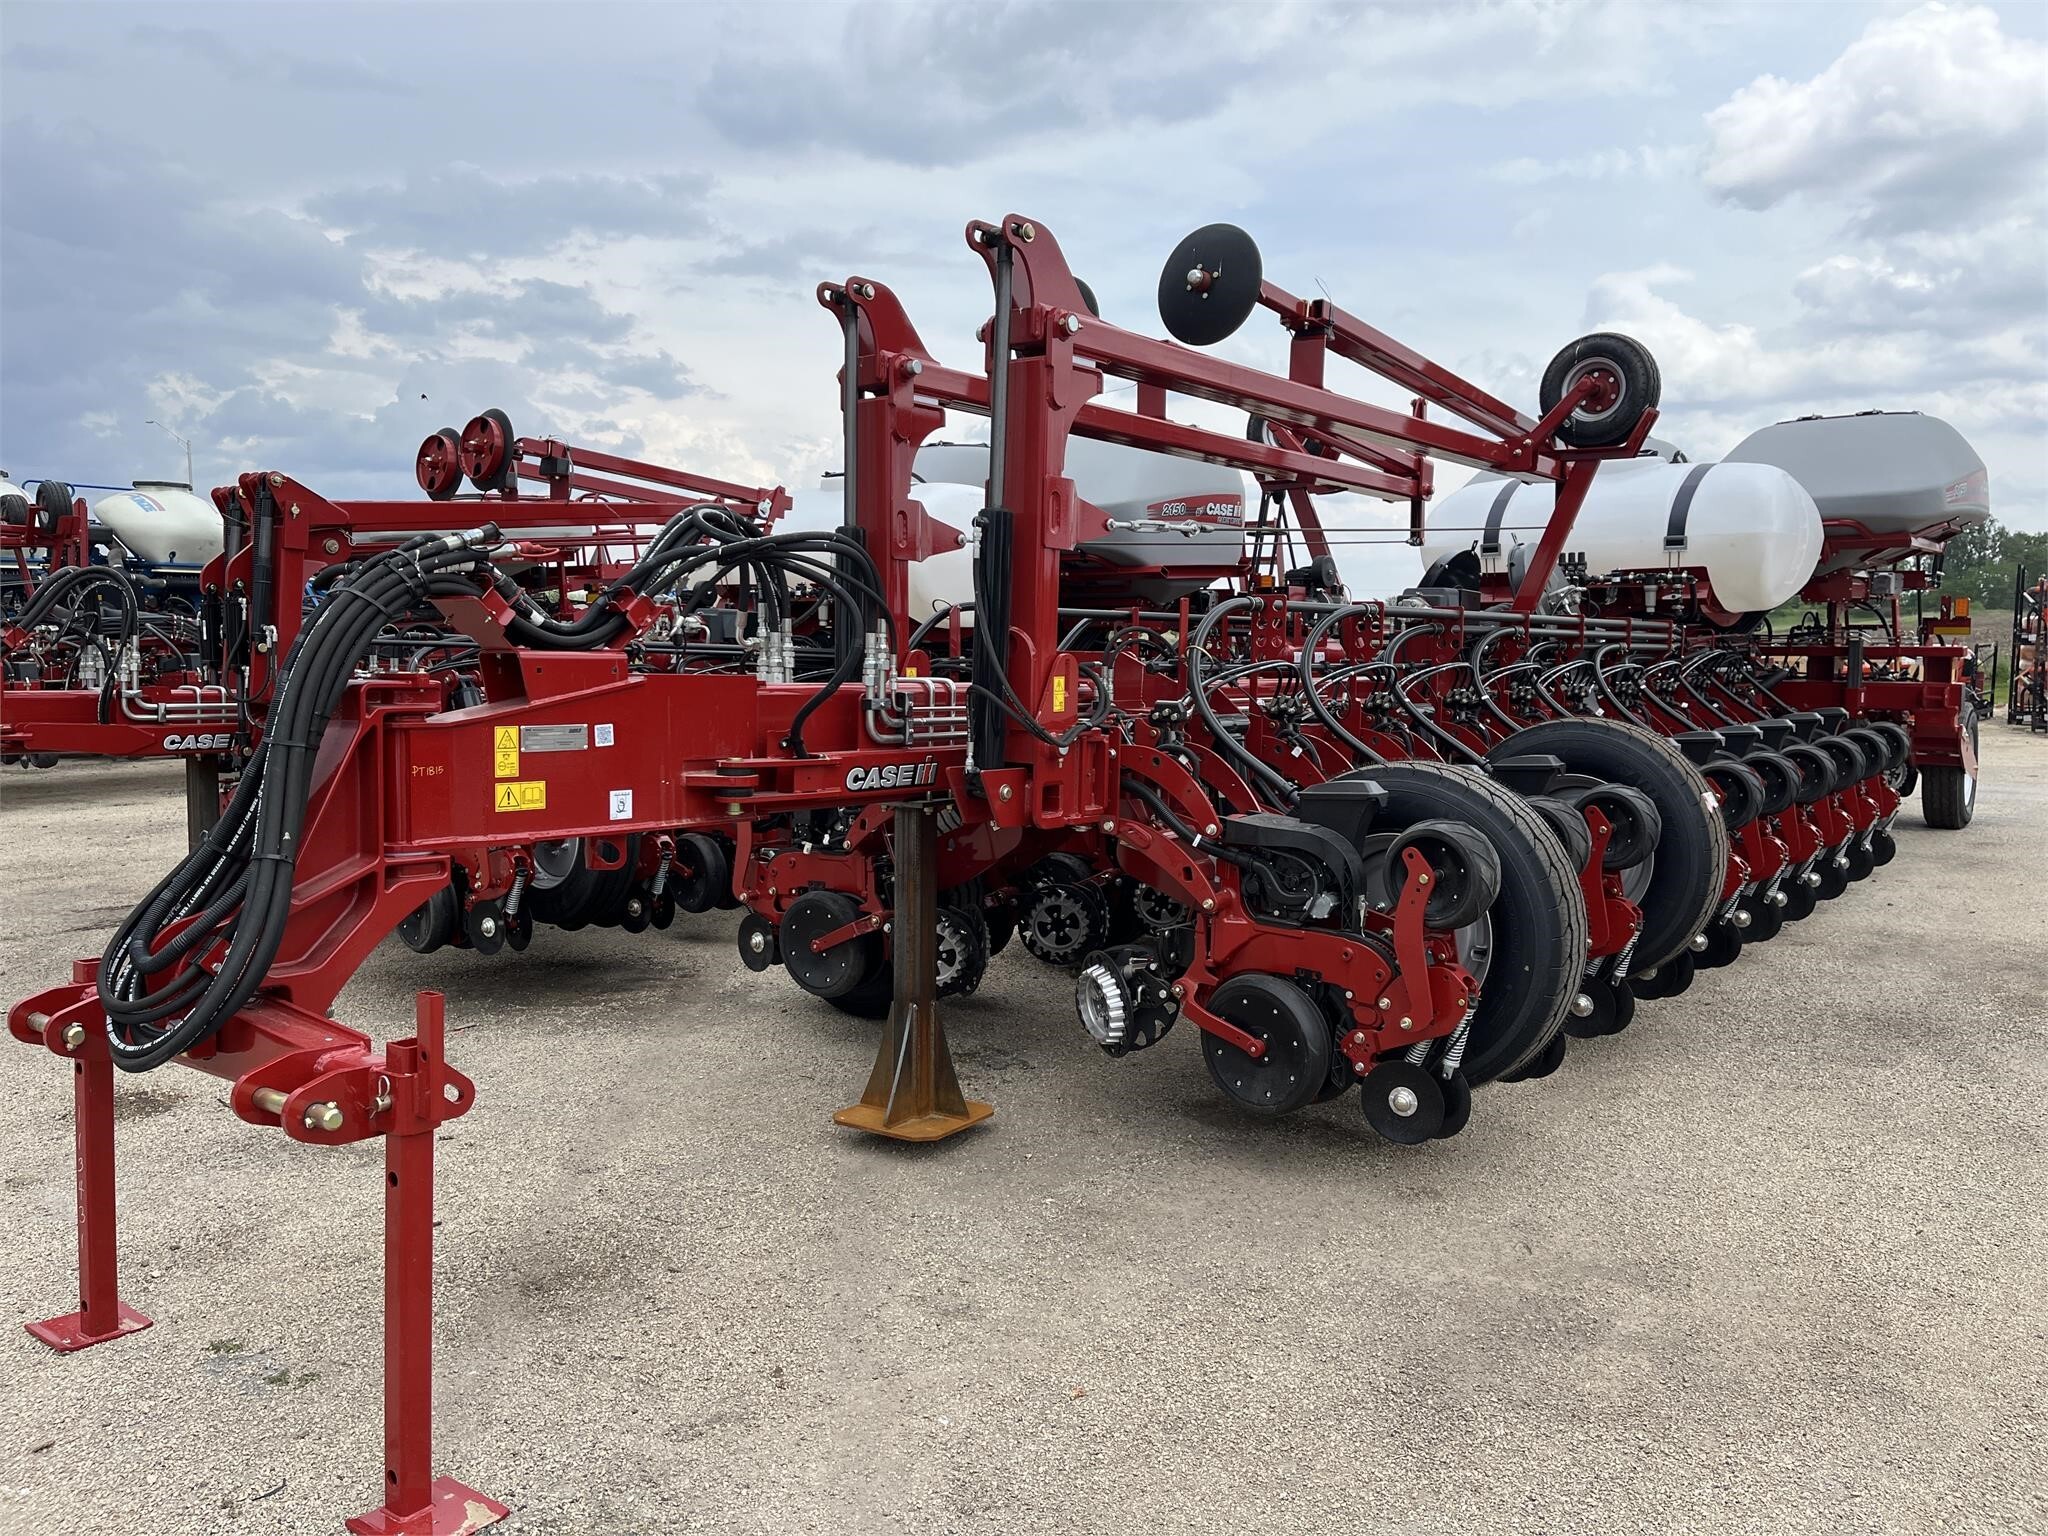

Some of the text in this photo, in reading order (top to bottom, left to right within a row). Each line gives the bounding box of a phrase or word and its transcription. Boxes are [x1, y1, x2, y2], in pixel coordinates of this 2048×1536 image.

[1162, 502, 1186, 516] 2150
[1206, 502, 1233, 517] CASE
[163, 734, 231, 751] CASE
[846, 765, 915, 791] CASE
